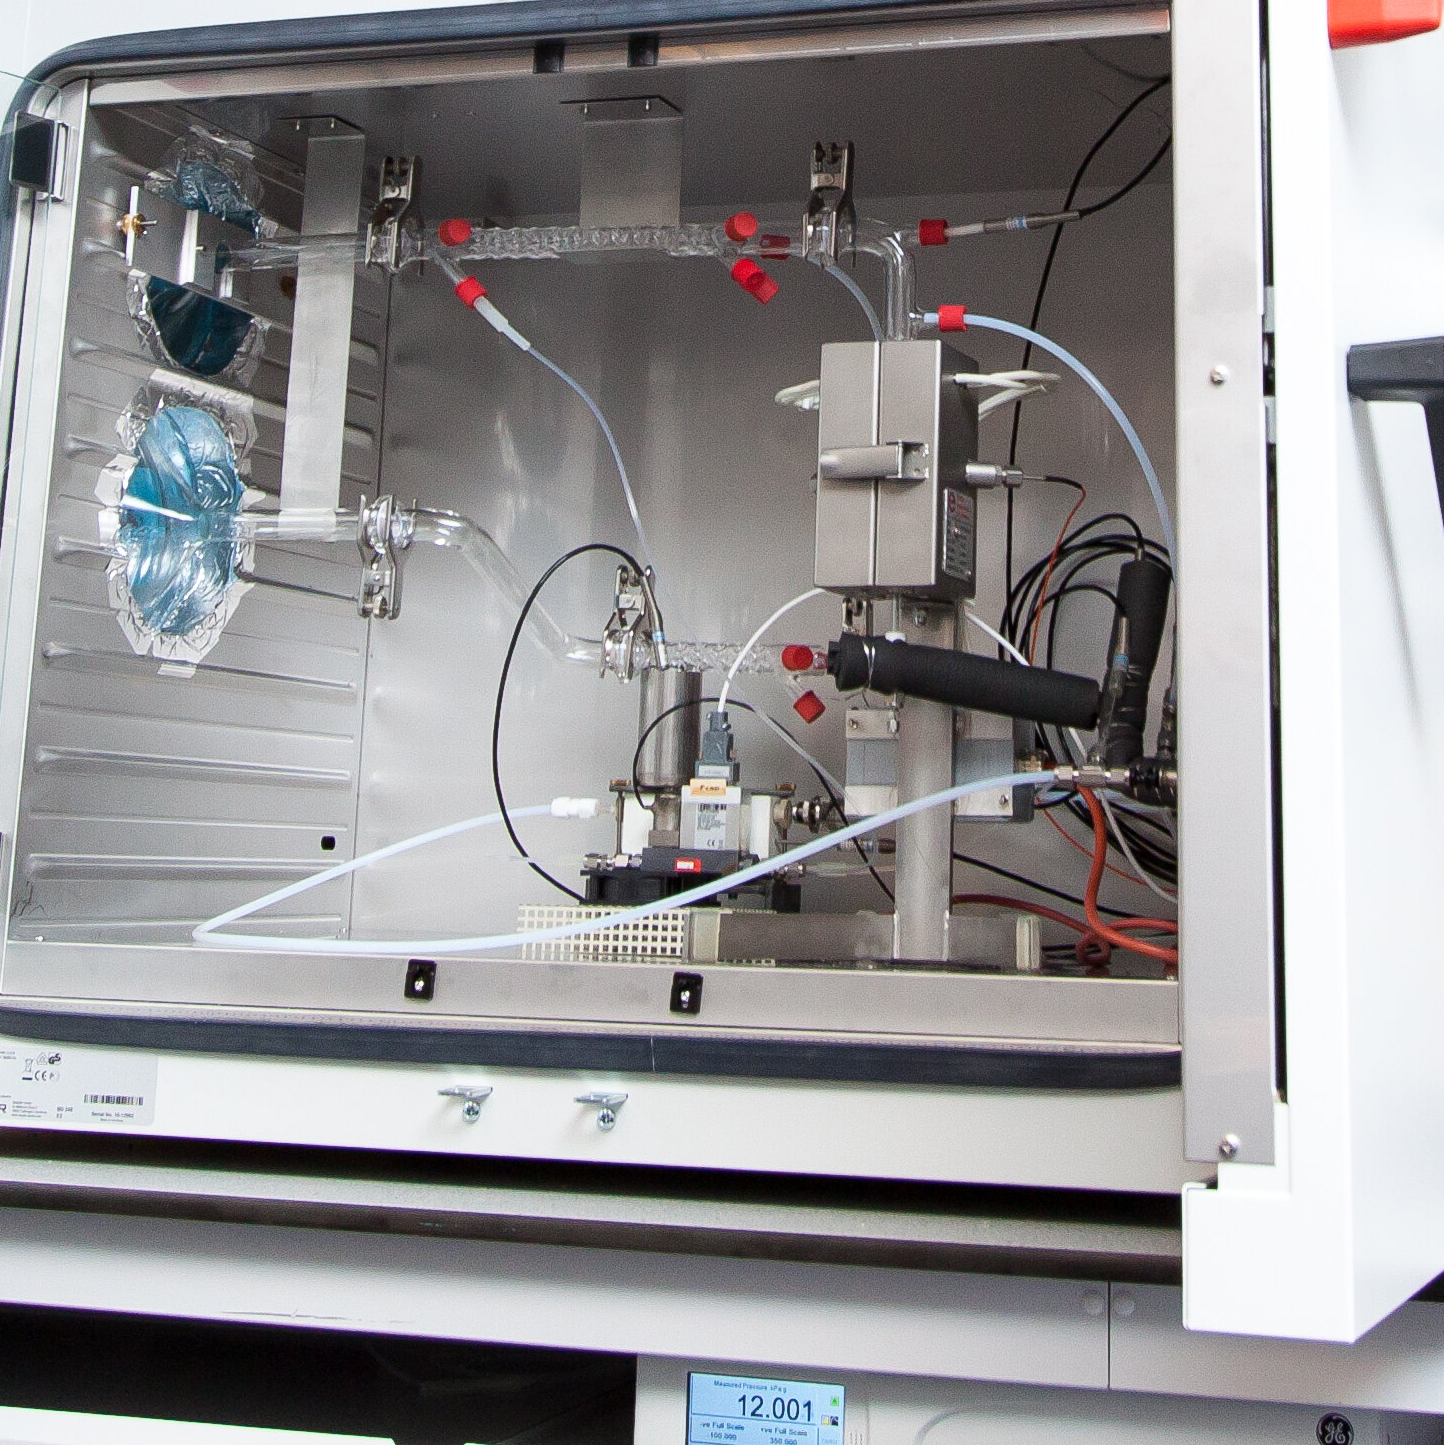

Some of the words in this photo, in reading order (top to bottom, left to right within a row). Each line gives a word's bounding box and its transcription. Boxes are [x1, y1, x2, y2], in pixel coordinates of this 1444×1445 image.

[713, 1379, 742, 1389] Measured
[738, 1394, 812, 1423] 12.001
[712, 1421, 725, 1430] Full
[774, 1427, 788, 1436] Full
